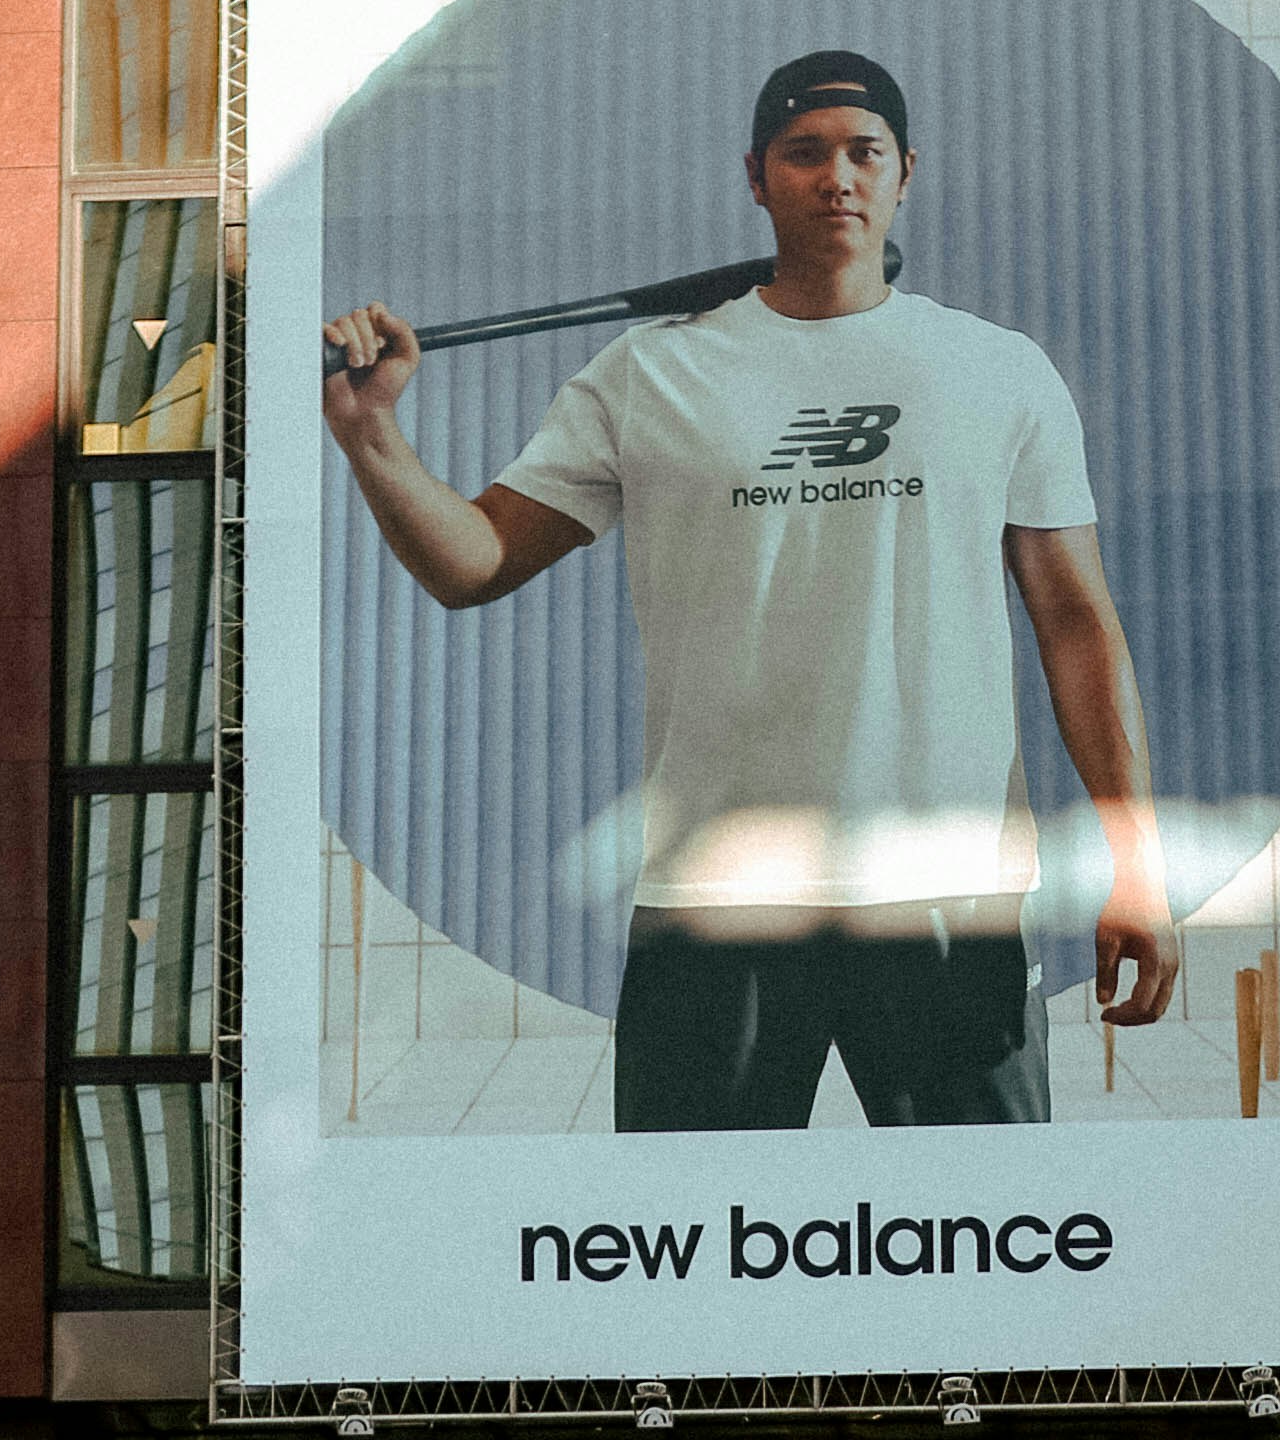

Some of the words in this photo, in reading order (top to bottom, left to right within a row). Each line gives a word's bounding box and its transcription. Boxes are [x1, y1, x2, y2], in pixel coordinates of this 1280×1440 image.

[732, 482, 792, 508] new
[800, 474, 924, 505] balance
[520, 1219, 703, 1283] new
[729, 1202, 1114, 1280] balance
